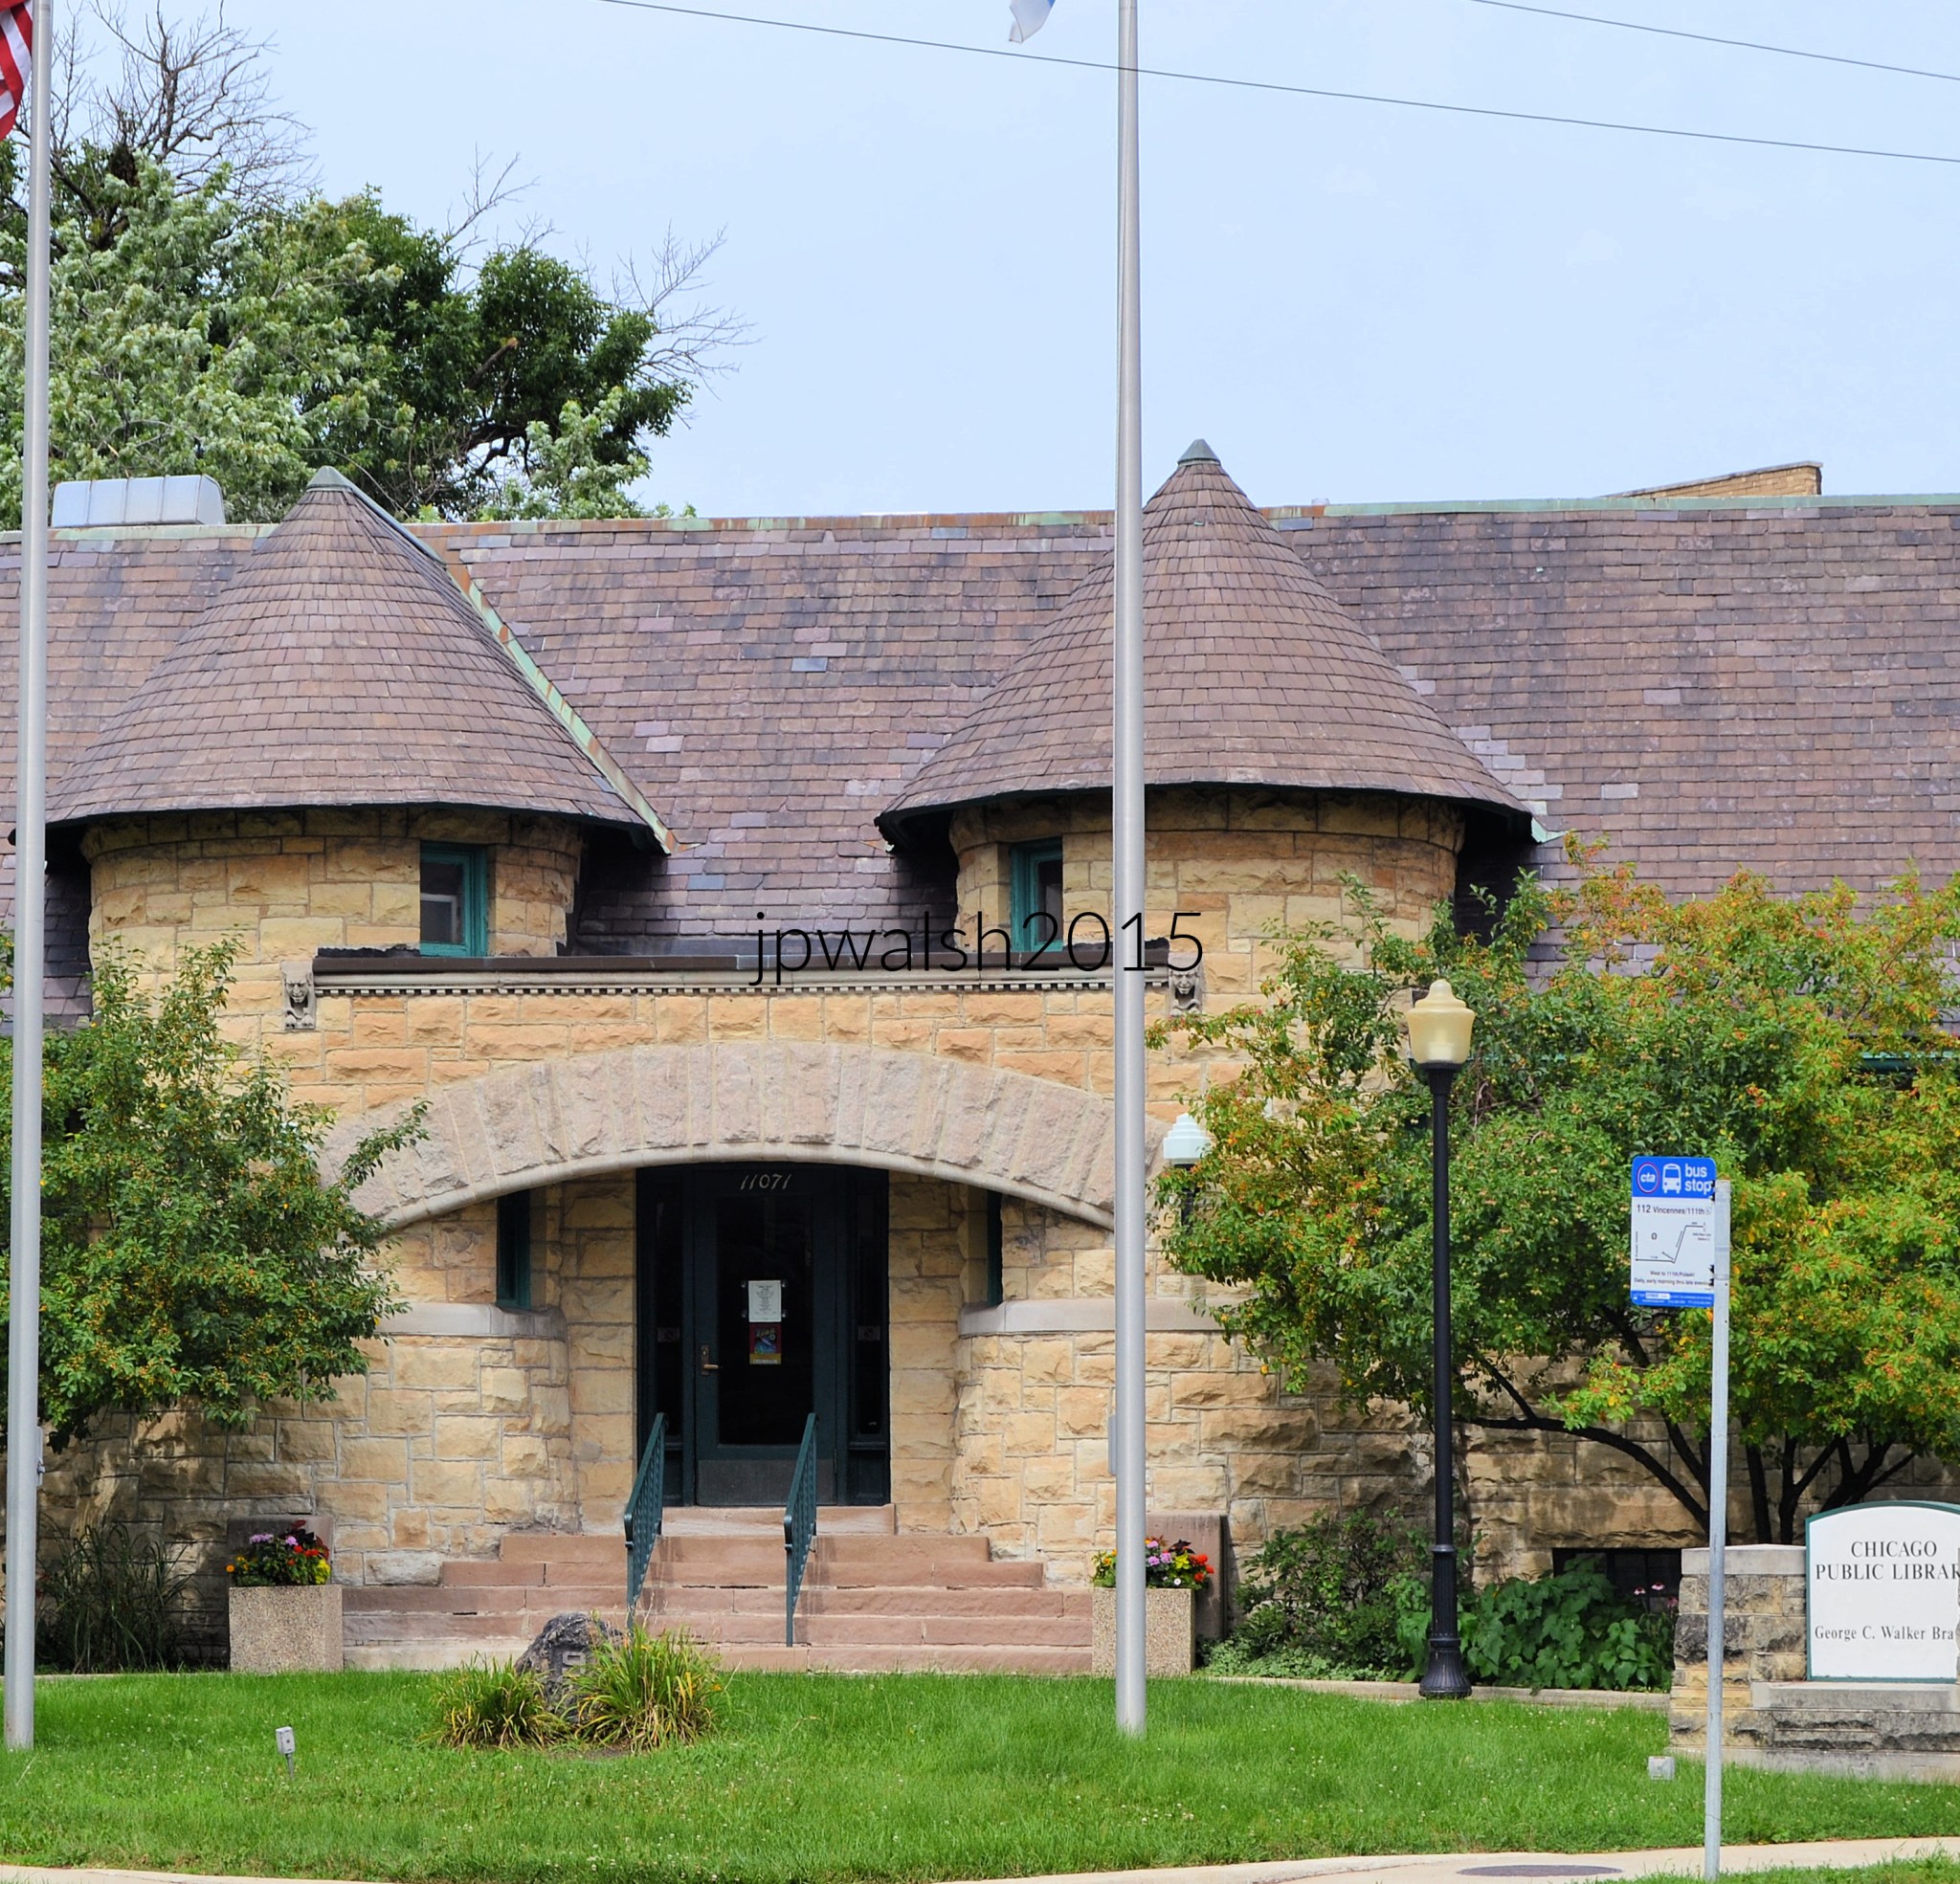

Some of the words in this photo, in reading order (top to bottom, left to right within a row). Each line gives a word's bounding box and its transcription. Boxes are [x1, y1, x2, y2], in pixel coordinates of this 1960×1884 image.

[1640, 1172, 1656, 1183] cta
[1684, 1164, 1707, 1178] bus
[741, 1173, 791, 1190] 11071
[1684, 1179, 1712, 1195] stop
[1637, 1205, 1651, 1213] 112
[1851, 1540, 1937, 1558] CHICAGO
[1815, 1563, 1884, 1580] PUBLIC
[1815, 1626, 1857, 1642] George
[1862, 1626, 1876, 1640] C.
[1881, 1626, 1926, 1640] Walker
[1932, 1626, 1954, 1640] Bra
